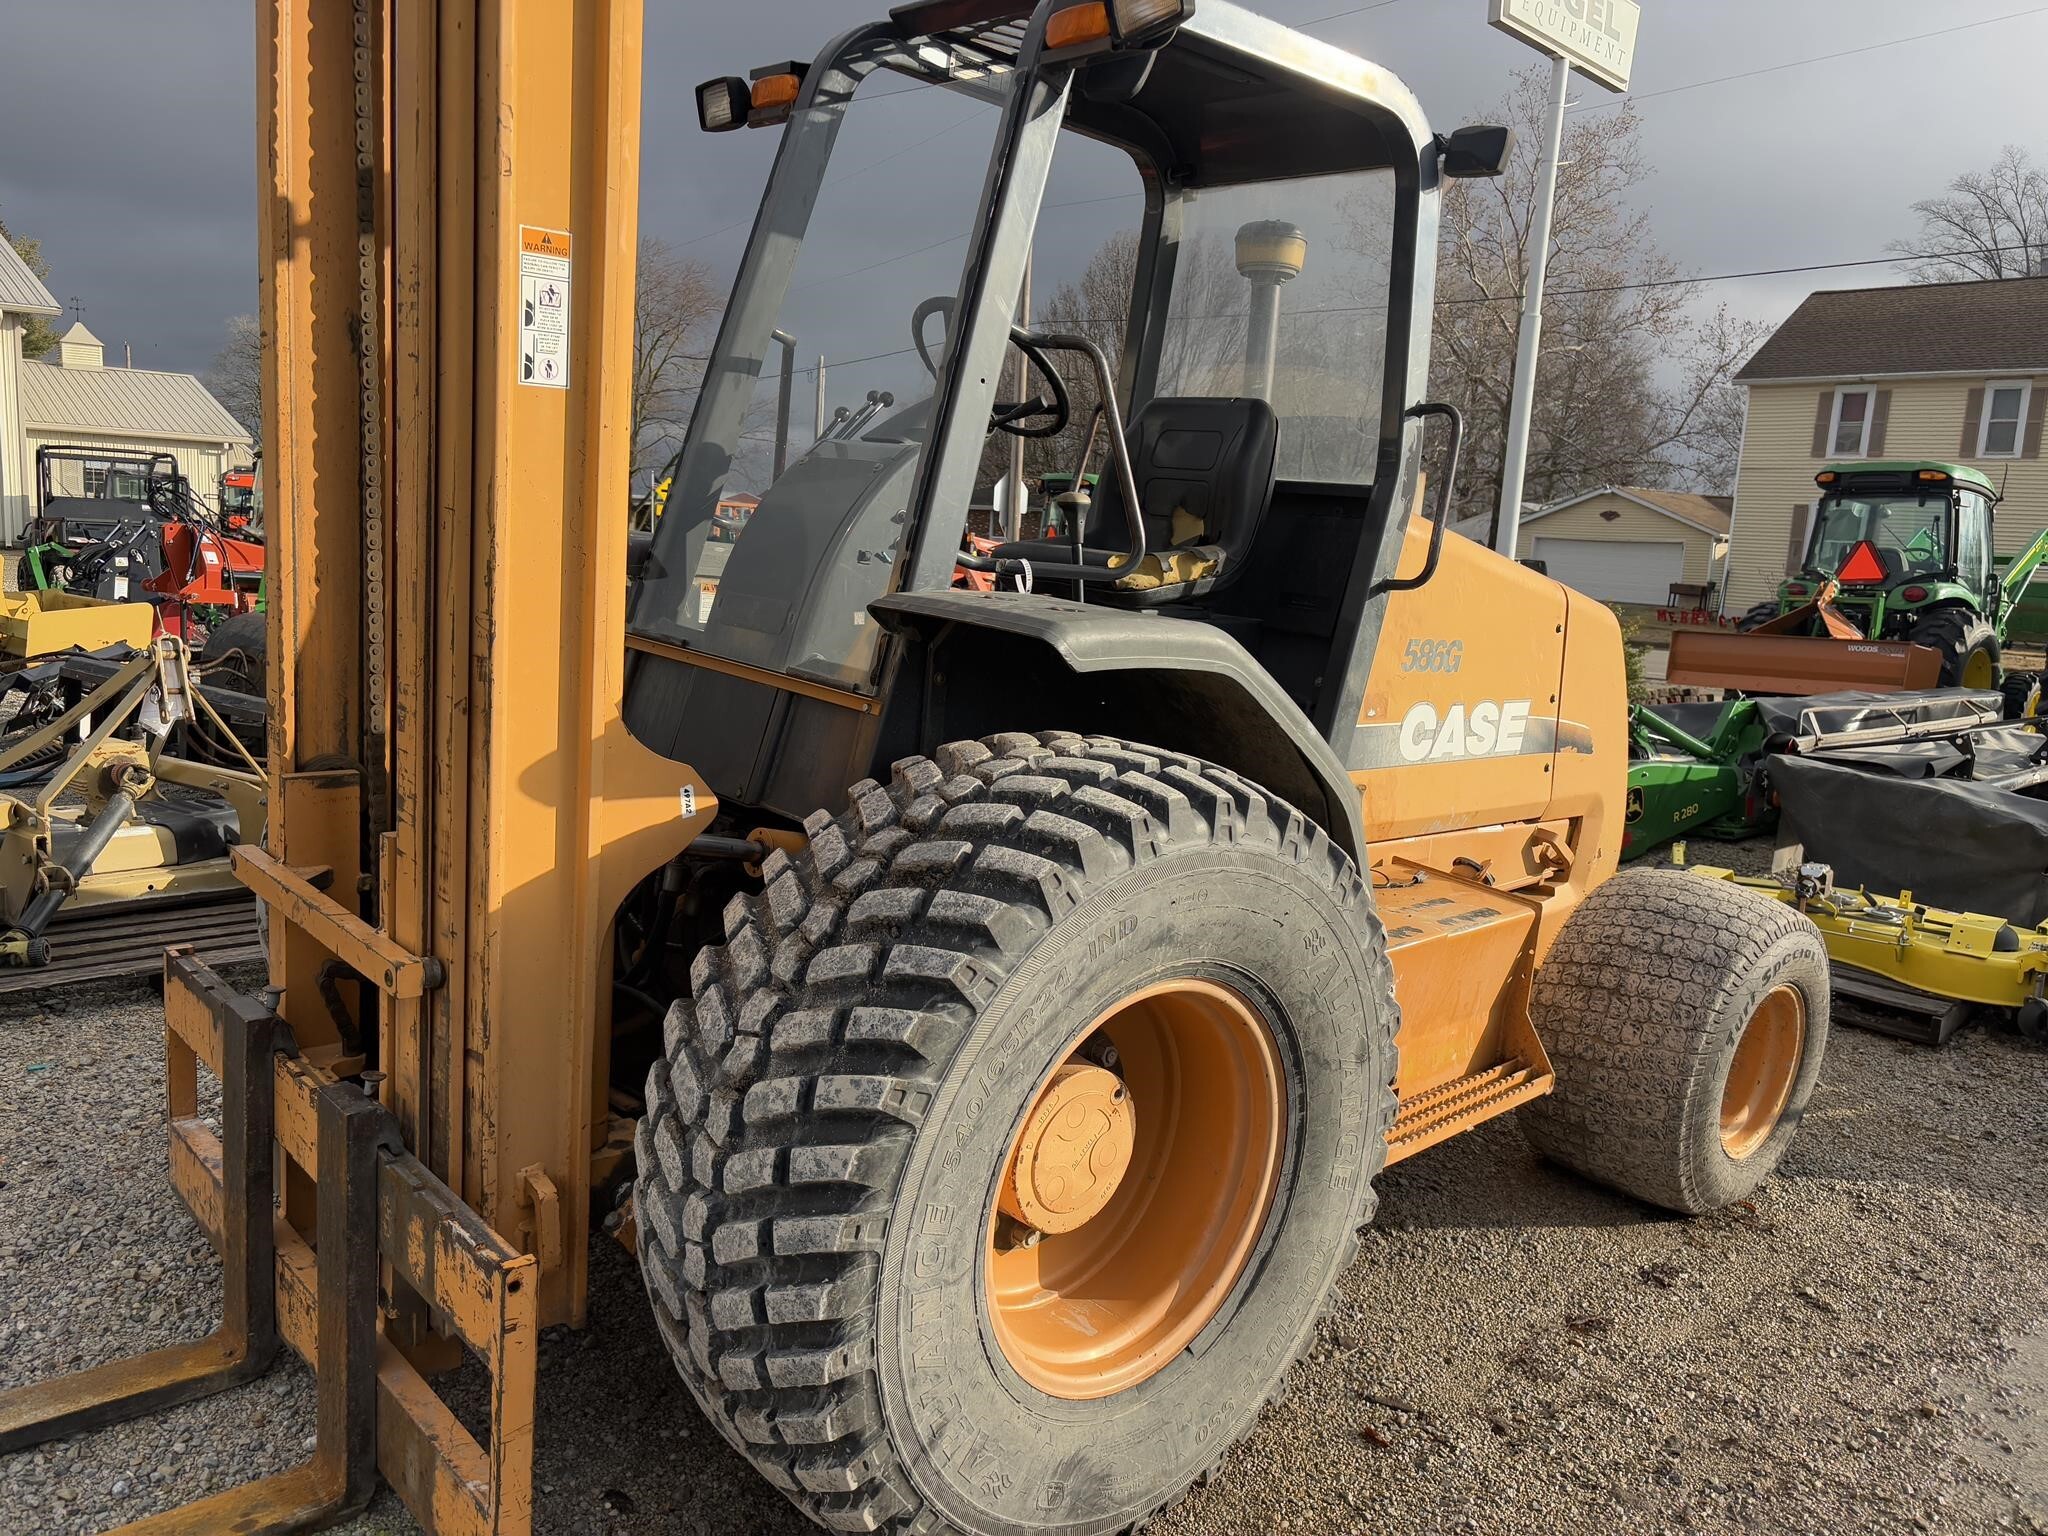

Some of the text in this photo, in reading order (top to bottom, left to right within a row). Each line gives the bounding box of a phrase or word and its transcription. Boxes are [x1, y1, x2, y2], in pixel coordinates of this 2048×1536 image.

[1522, 0, 1627, 65] EQUIPMENT
[1554, 0, 1621, 42] GEL
[524, 242, 568, 257] WARNING
[1401, 639, 1464, 673] 586G
[1847, 644, 1879, 653] WOODS
[1400, 699, 1532, 762] CASE
[1673, 803, 1699, 823] R 280
[942, 914, 1139, 1174] 540/65R24 IND
[1313, 951, 1363, 1191] ALLIANCE
[910, 1202, 1001, 1484] ALLIANCE
[1239, 1234, 1332, 1398] MULTIUSE
[1194, 1400, 1235, 1447] 550
